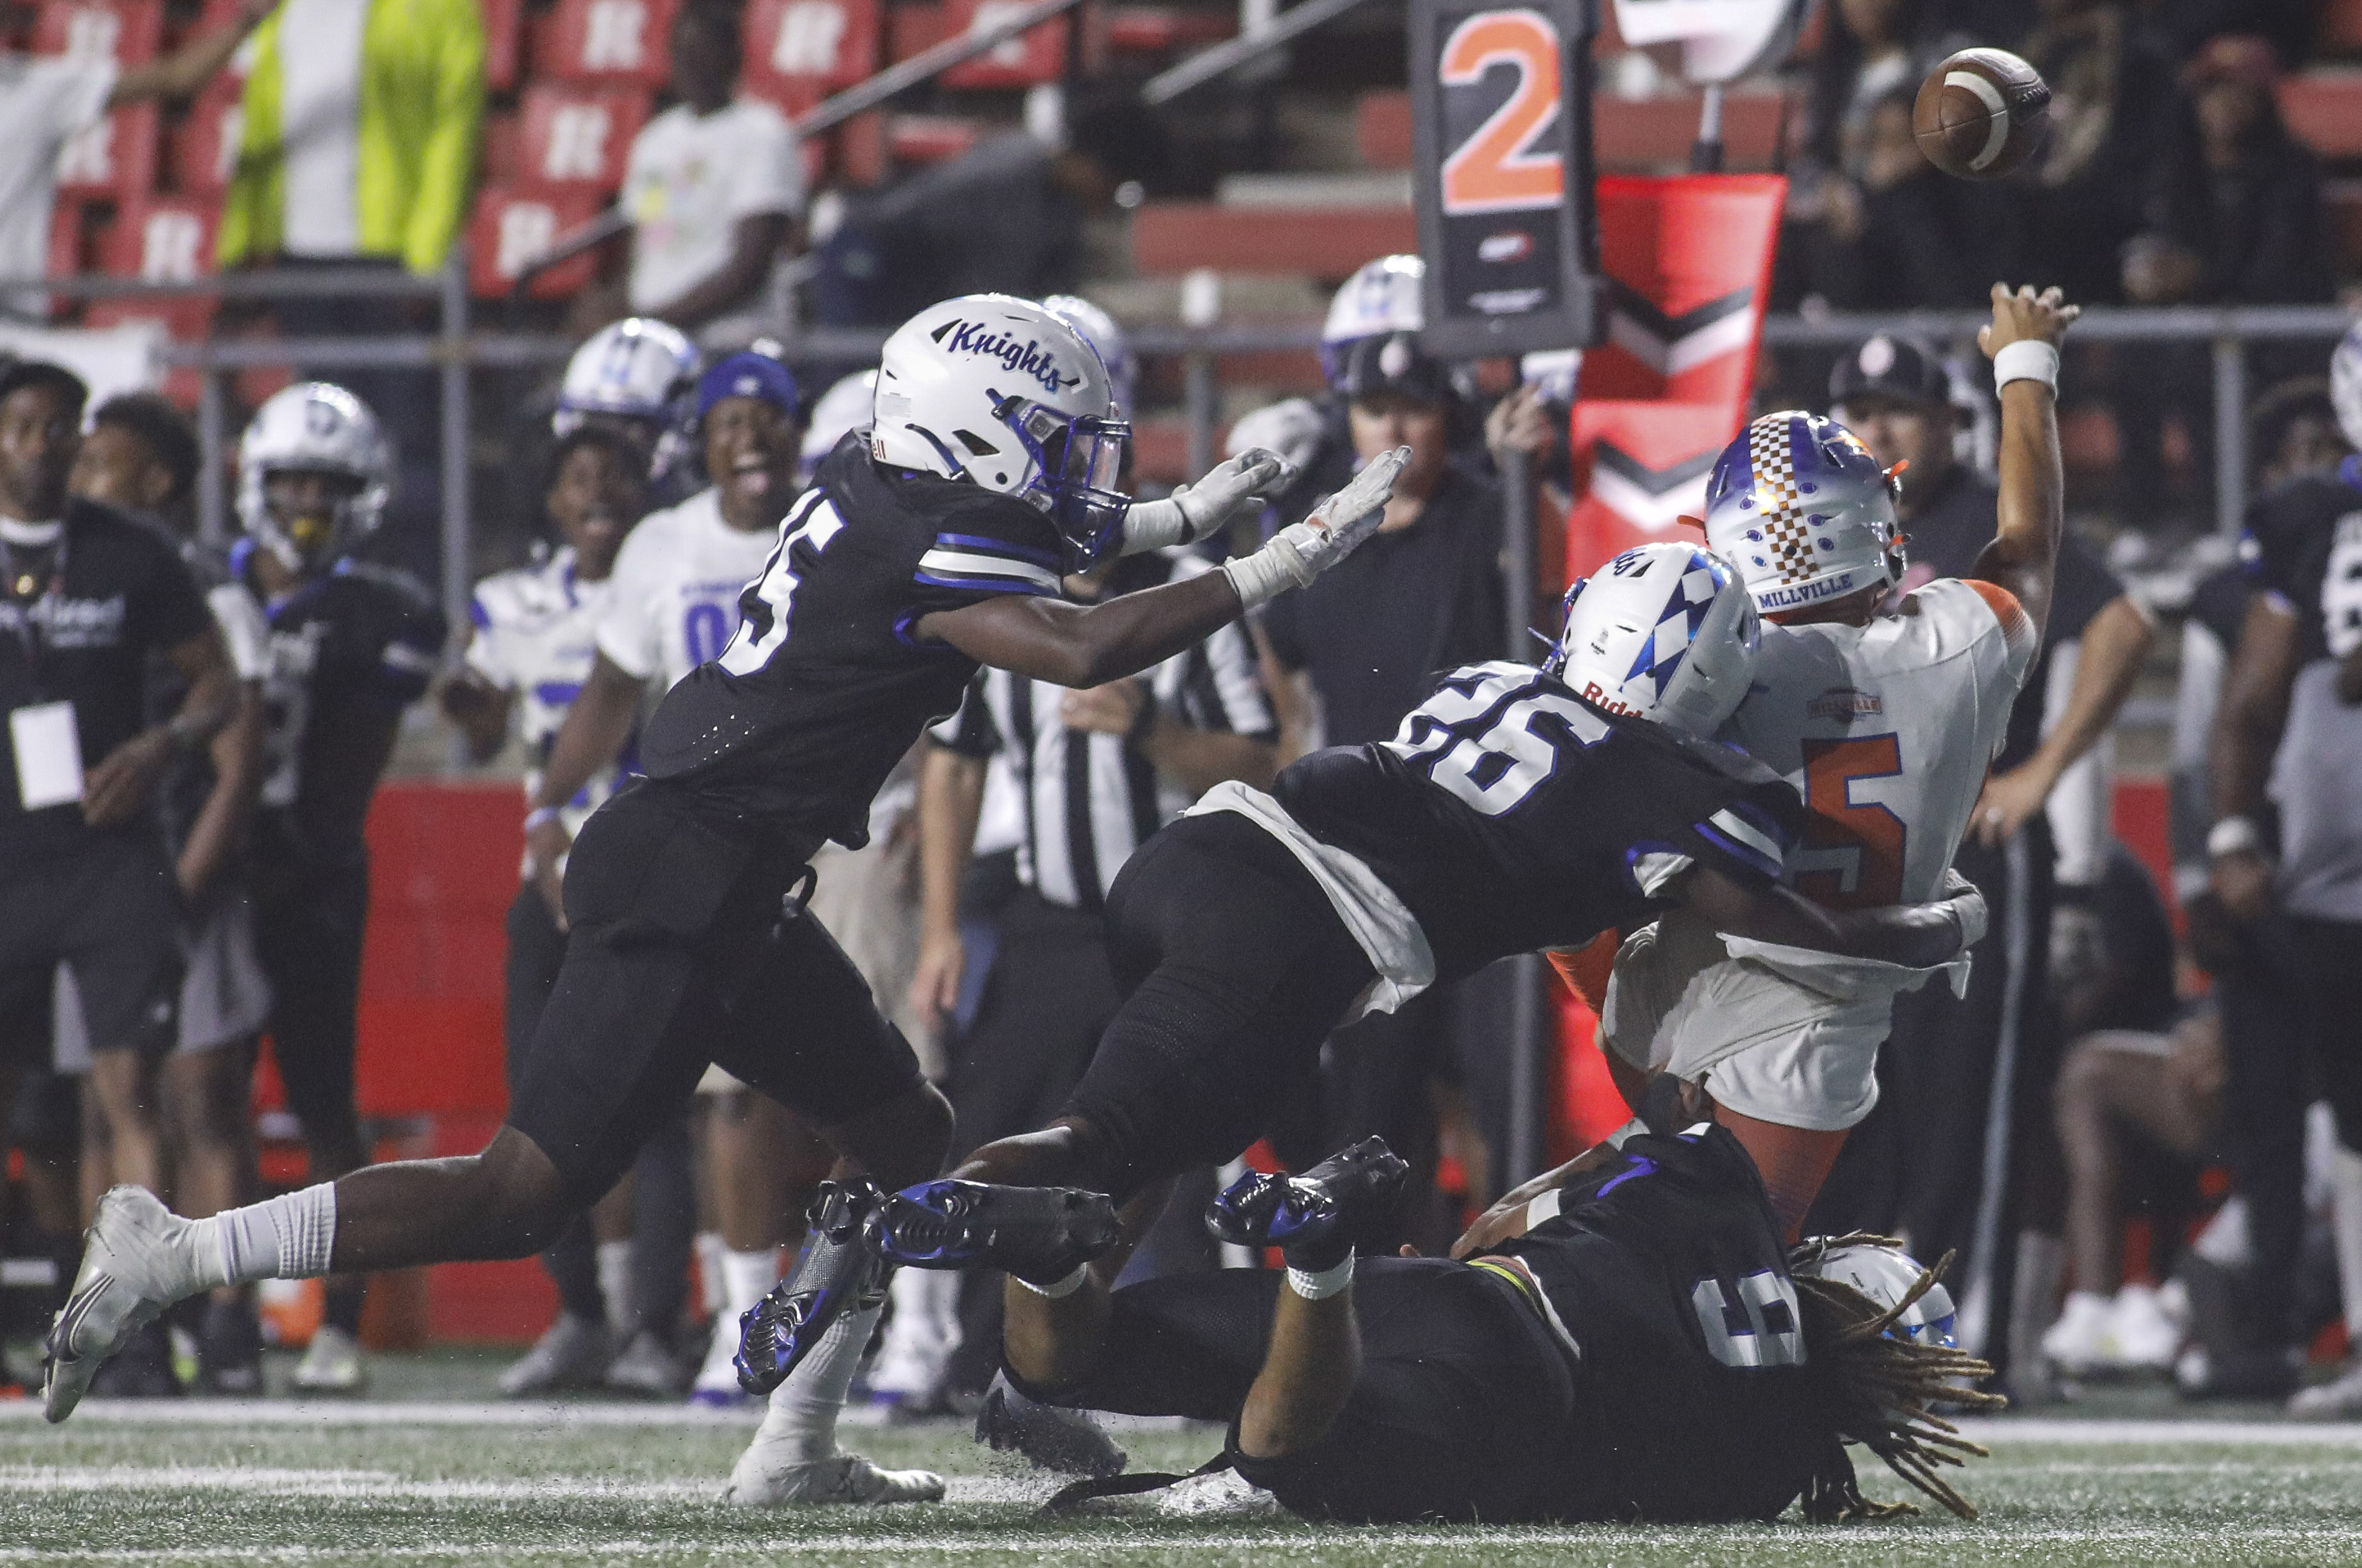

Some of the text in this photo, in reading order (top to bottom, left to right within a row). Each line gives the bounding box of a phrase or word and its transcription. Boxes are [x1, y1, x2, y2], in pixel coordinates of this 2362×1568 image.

[1440, 6, 1566, 217] 2
[947, 322, 1060, 393] Knights
[1758, 573, 1853, 609] MILLVILLE
[1378, 659, 1616, 817] 26
[1794, 731, 1908, 909] 5
